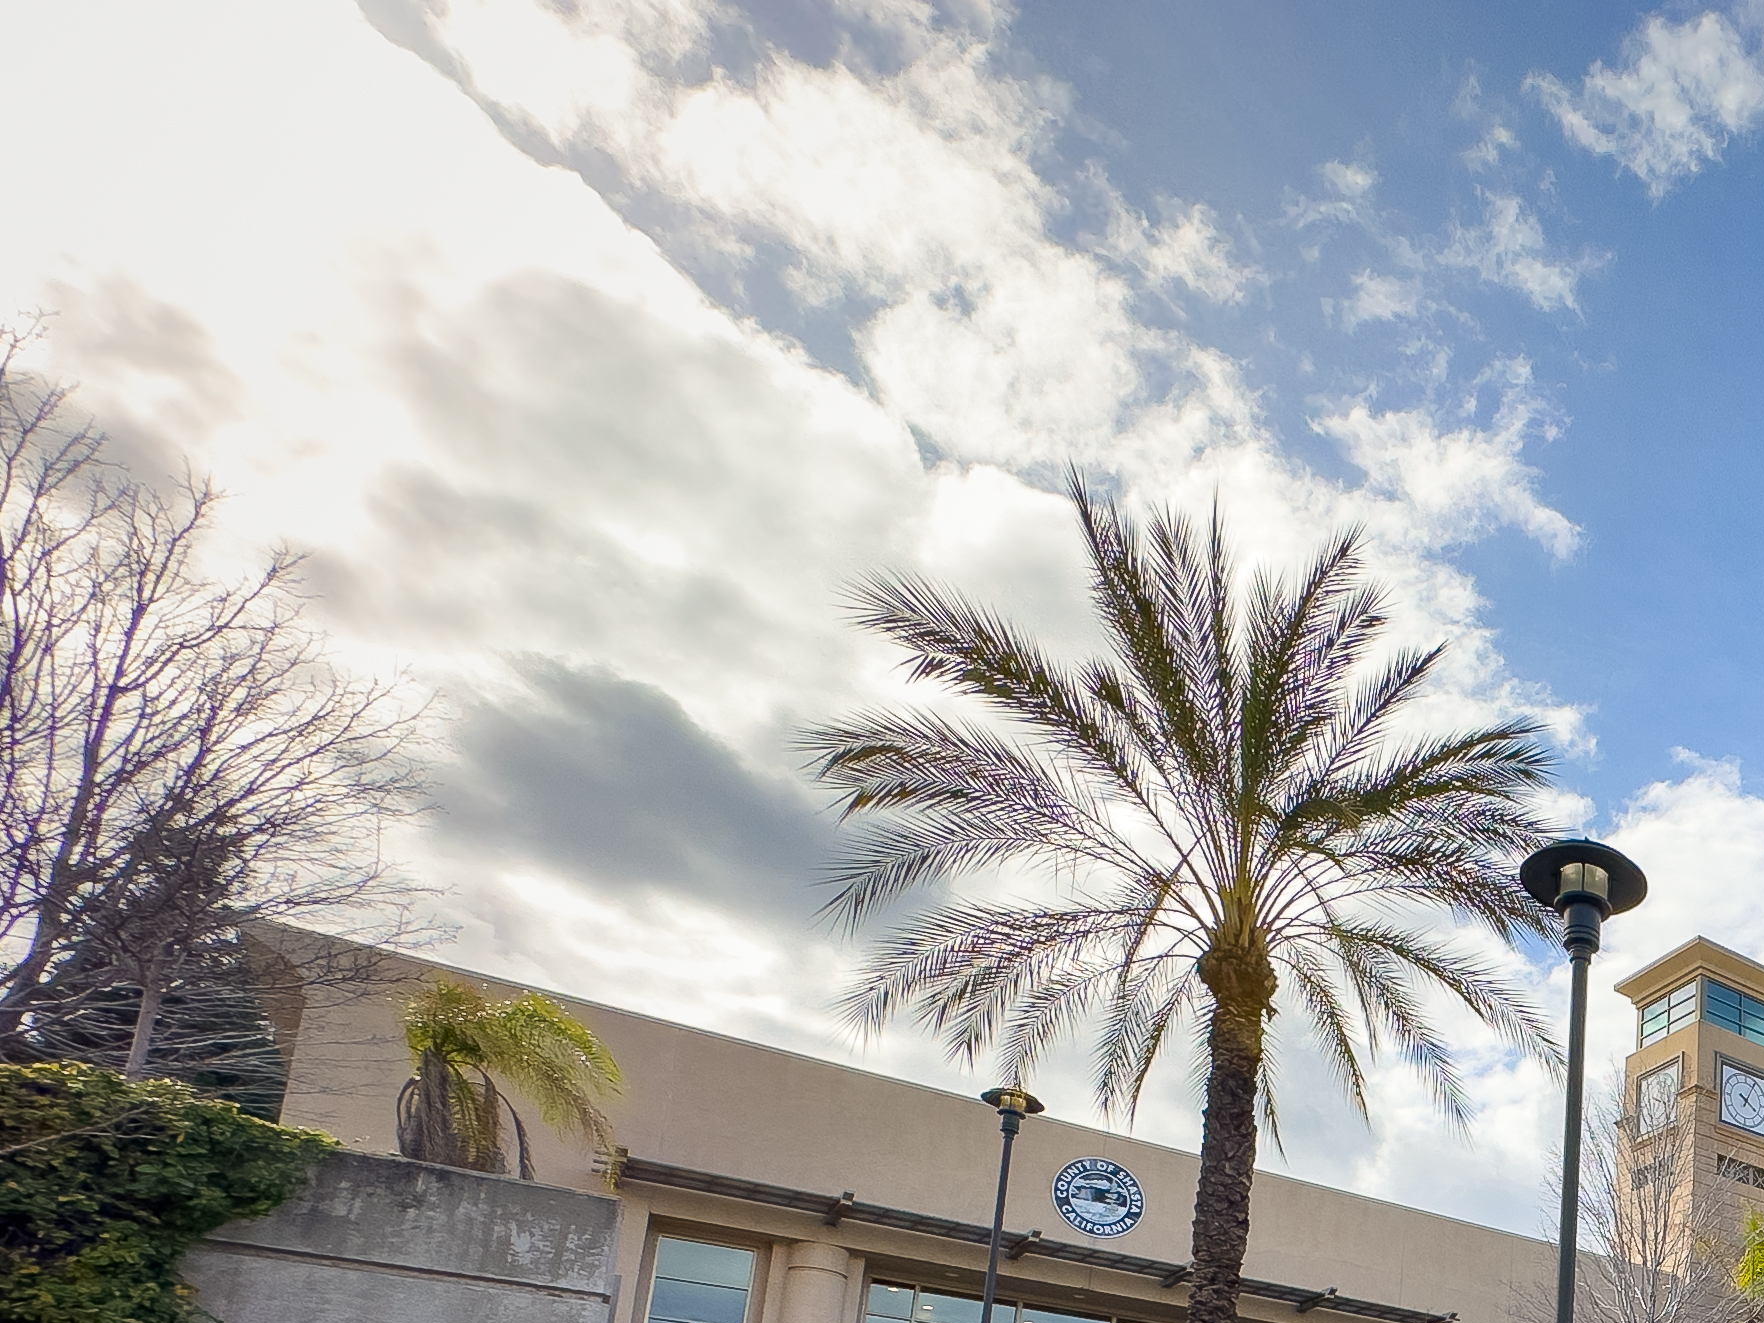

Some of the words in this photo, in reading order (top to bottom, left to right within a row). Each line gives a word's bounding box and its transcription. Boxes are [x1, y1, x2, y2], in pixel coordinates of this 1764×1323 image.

[1056, 1160, 1091, 1198] COUNTY
[1096, 1161, 1116, 1172] OF
[1117, 1170, 1142, 1214] SHASTA
[1061, 1204, 1134, 1234] CALIFORNIA
